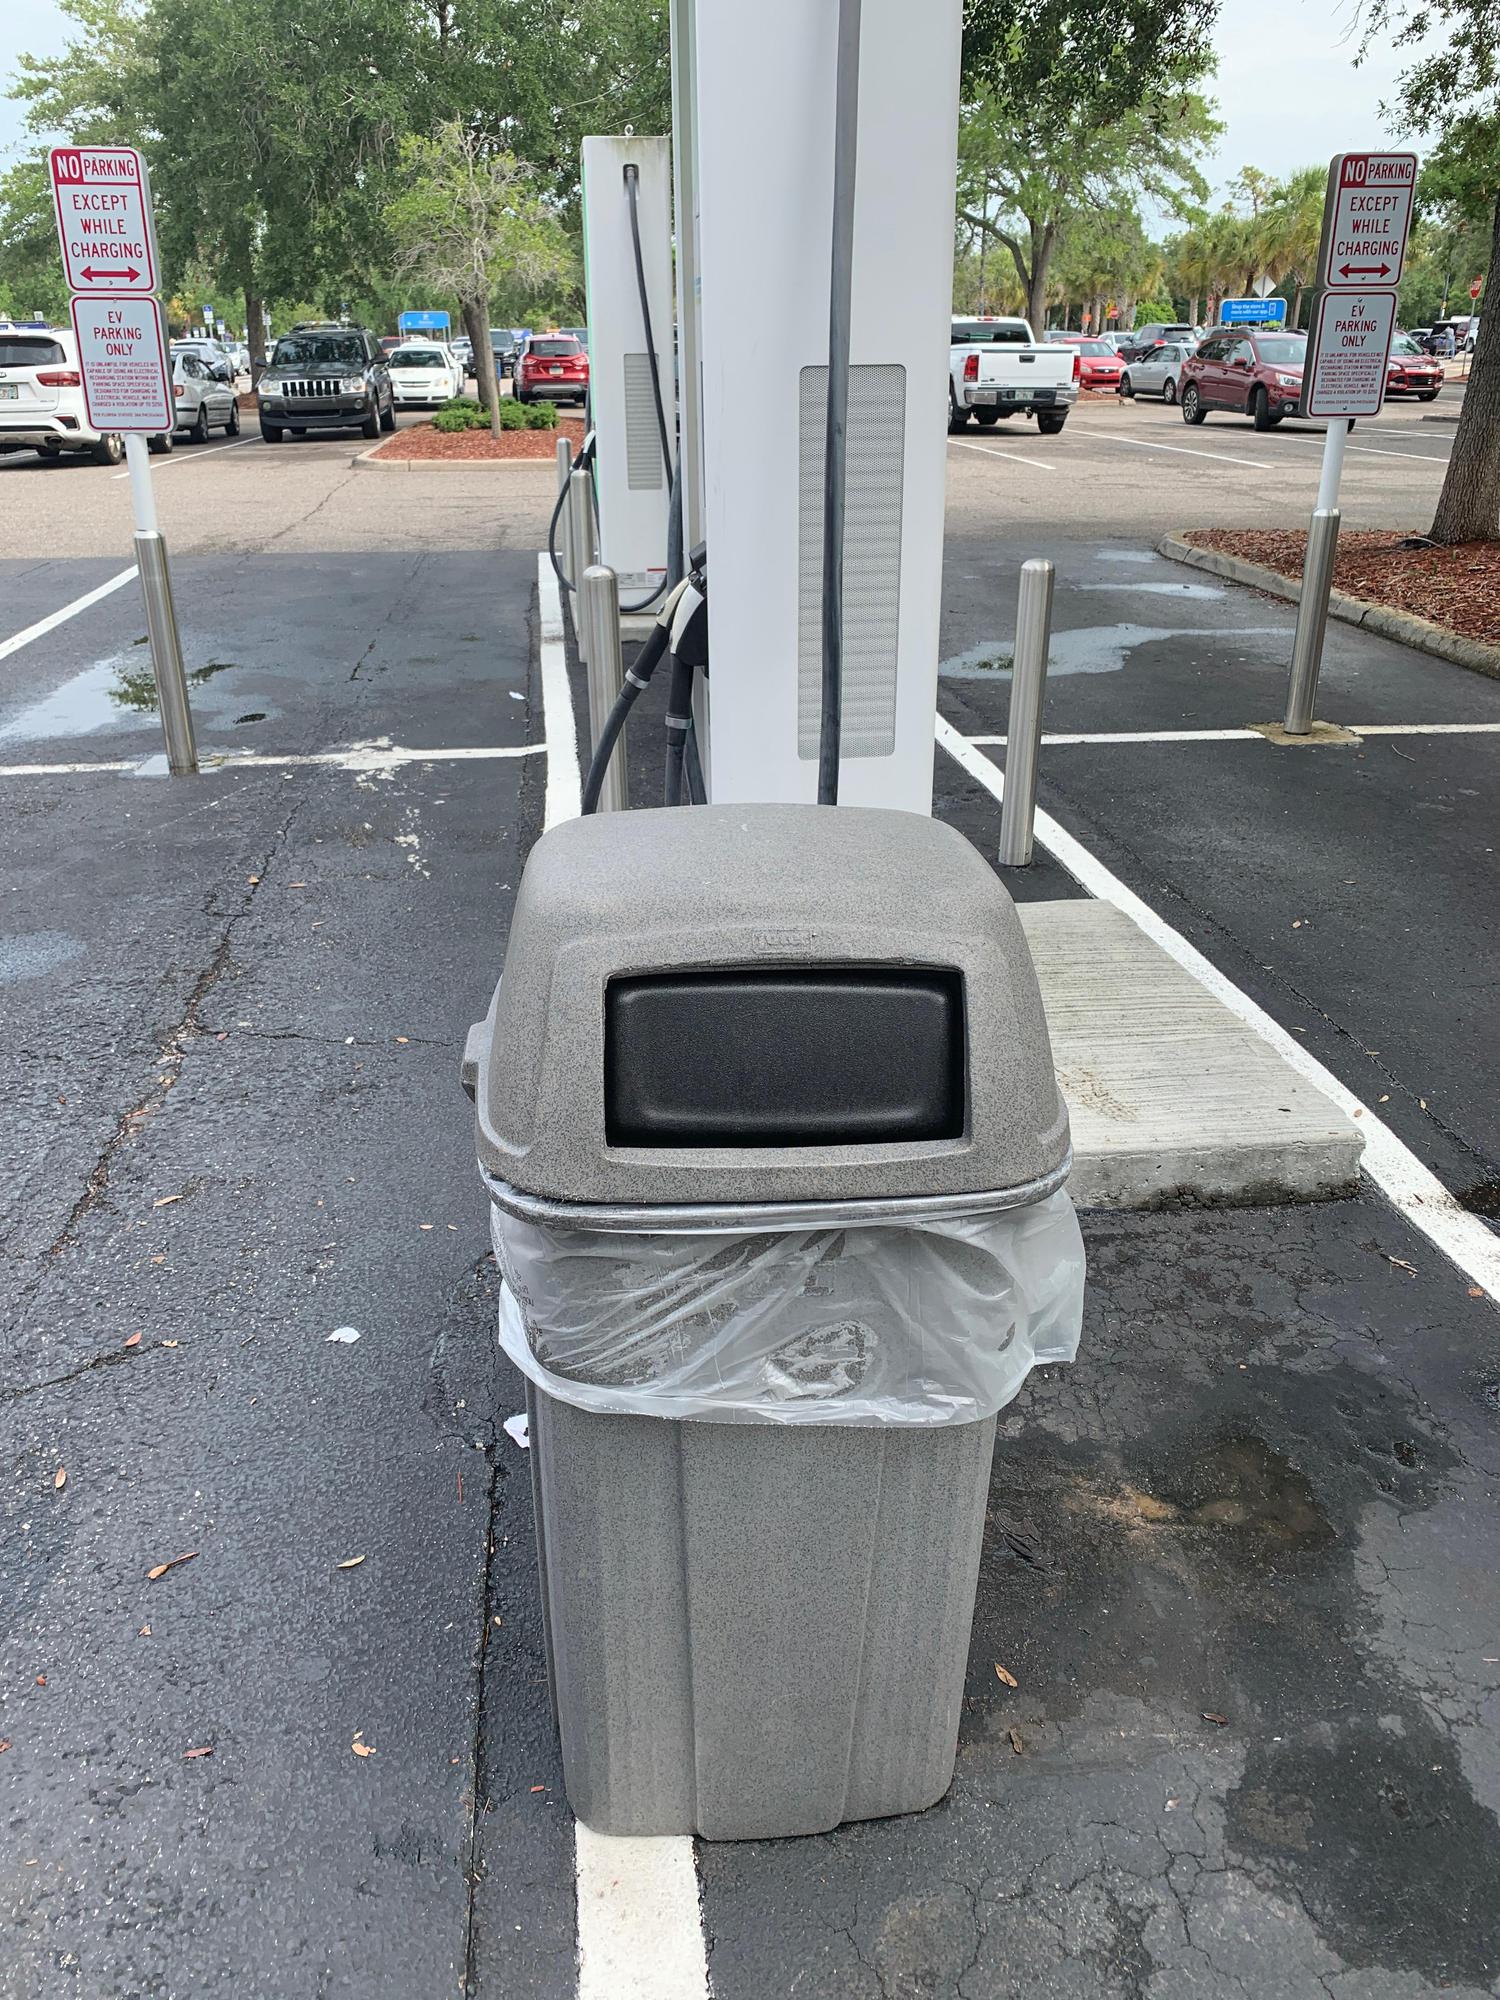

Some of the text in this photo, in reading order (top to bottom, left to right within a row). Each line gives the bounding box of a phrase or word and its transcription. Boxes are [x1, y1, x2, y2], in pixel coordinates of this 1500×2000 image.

[56, 155, 134, 178] NO PARKING
[1344, 160, 1412, 182] NO PARKING
[72, 194, 127, 210] EXCEPT
[1350, 196, 1399, 211] EXCEPT
[80, 219, 126, 234] WHILE
[1352, 219, 1391, 234] WHILE
[71, 242, 143, 258] CHARGING
[1337, 241, 1399, 256] CHARGING
[108, 312, 122, 324] EV
[1352, 305, 1365, 317] EV
[1335, 320, 1377, 332] PARKING
[93, 328, 142, 340] PARKING
[1342, 335, 1366, 347] ONLY
[106, 343, 133, 356] ONLY
